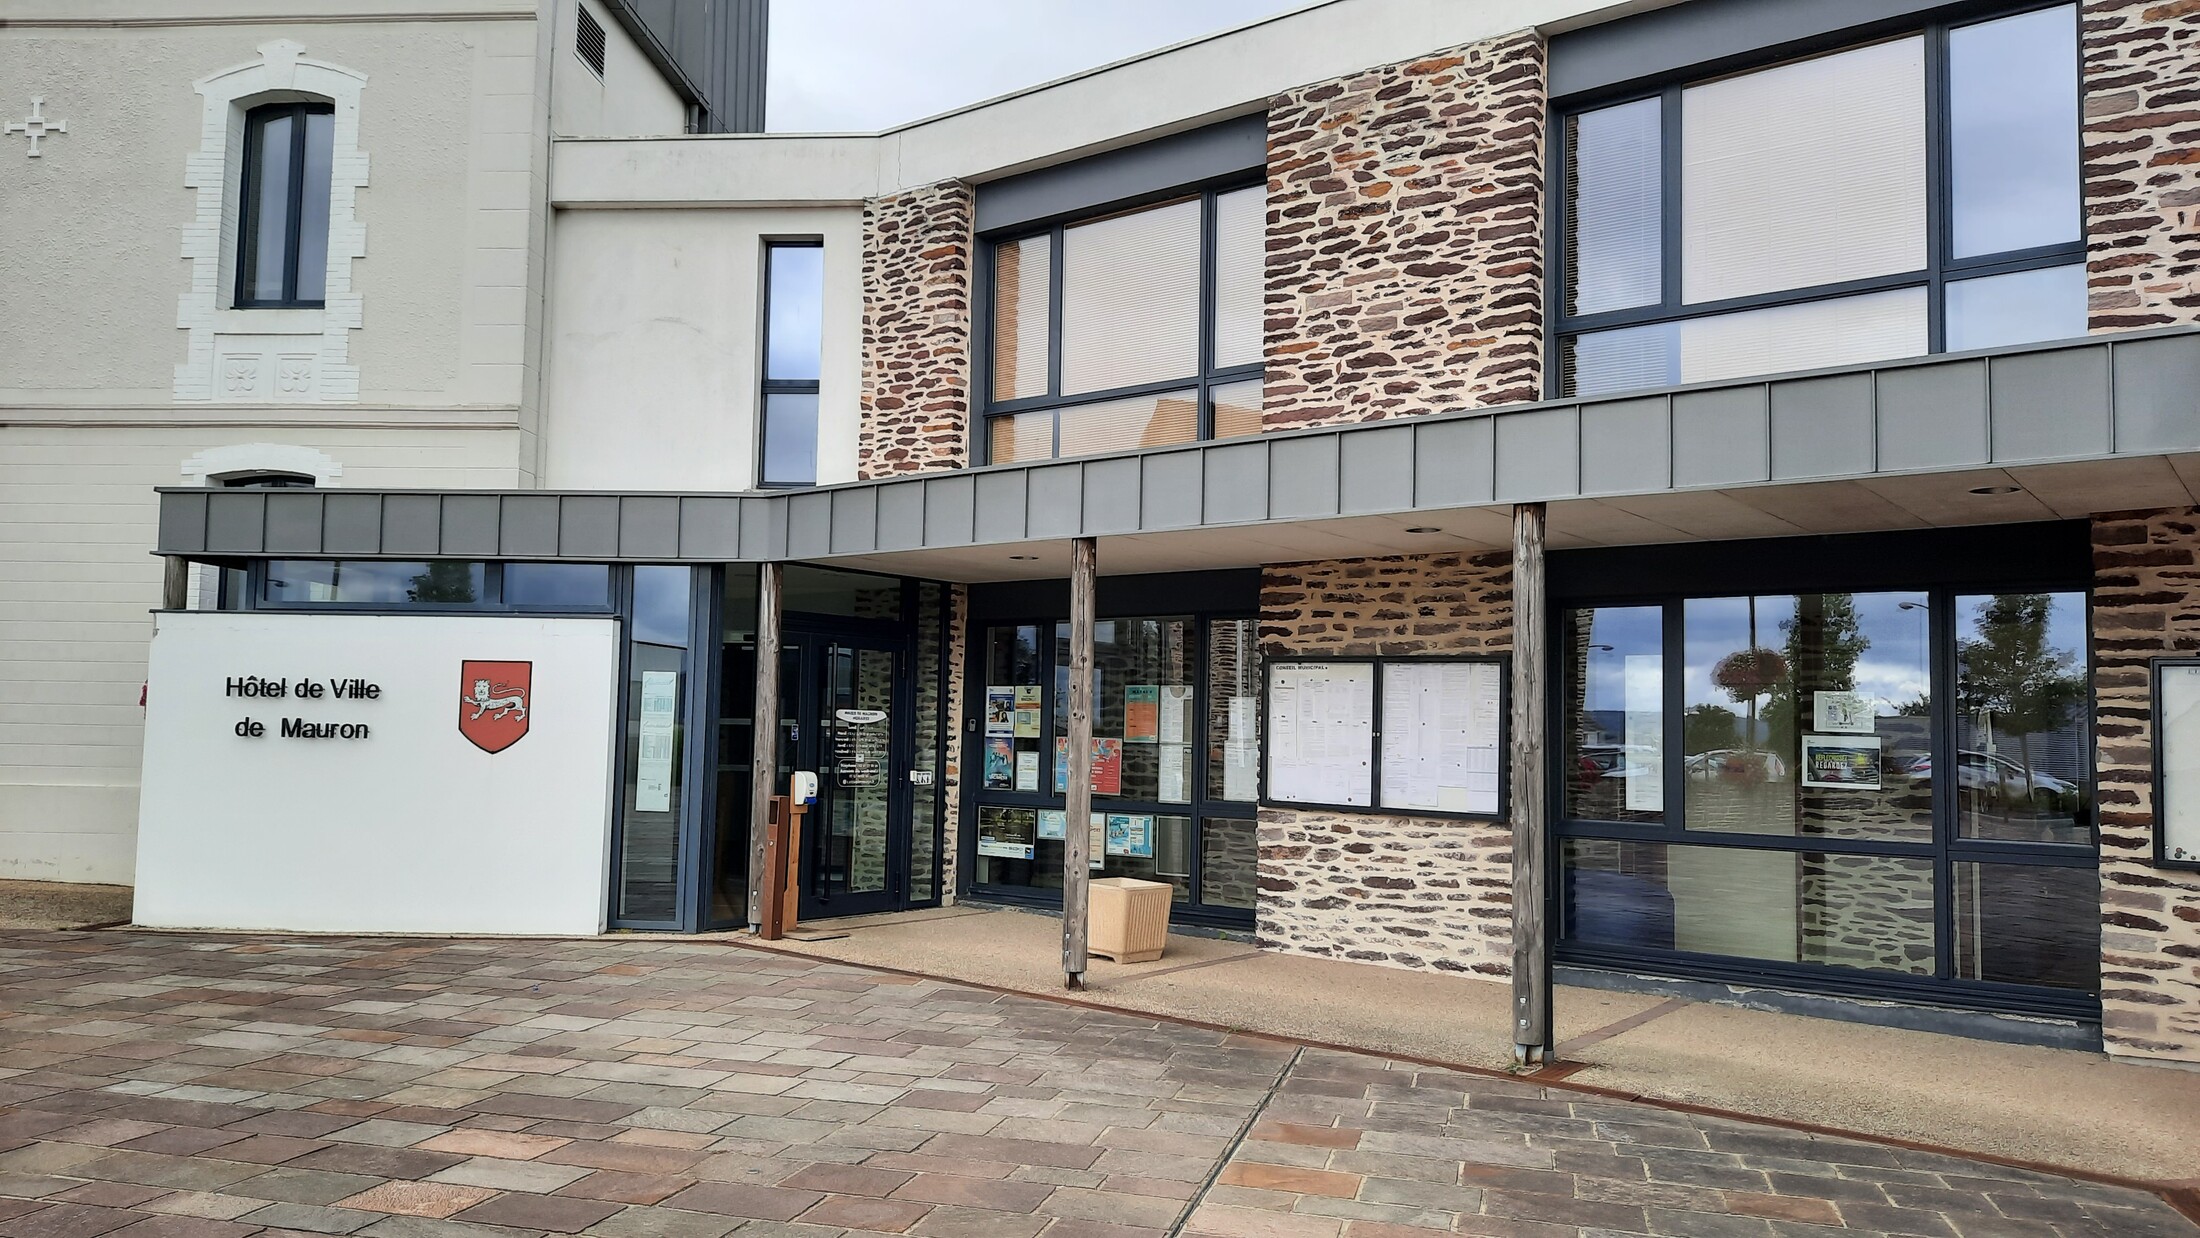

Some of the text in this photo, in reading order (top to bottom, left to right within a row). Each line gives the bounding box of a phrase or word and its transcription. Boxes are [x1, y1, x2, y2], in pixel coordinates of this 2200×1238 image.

[226, 676, 381, 699] Hôtel de Ville
[235, 716, 369, 739] de Mauron
